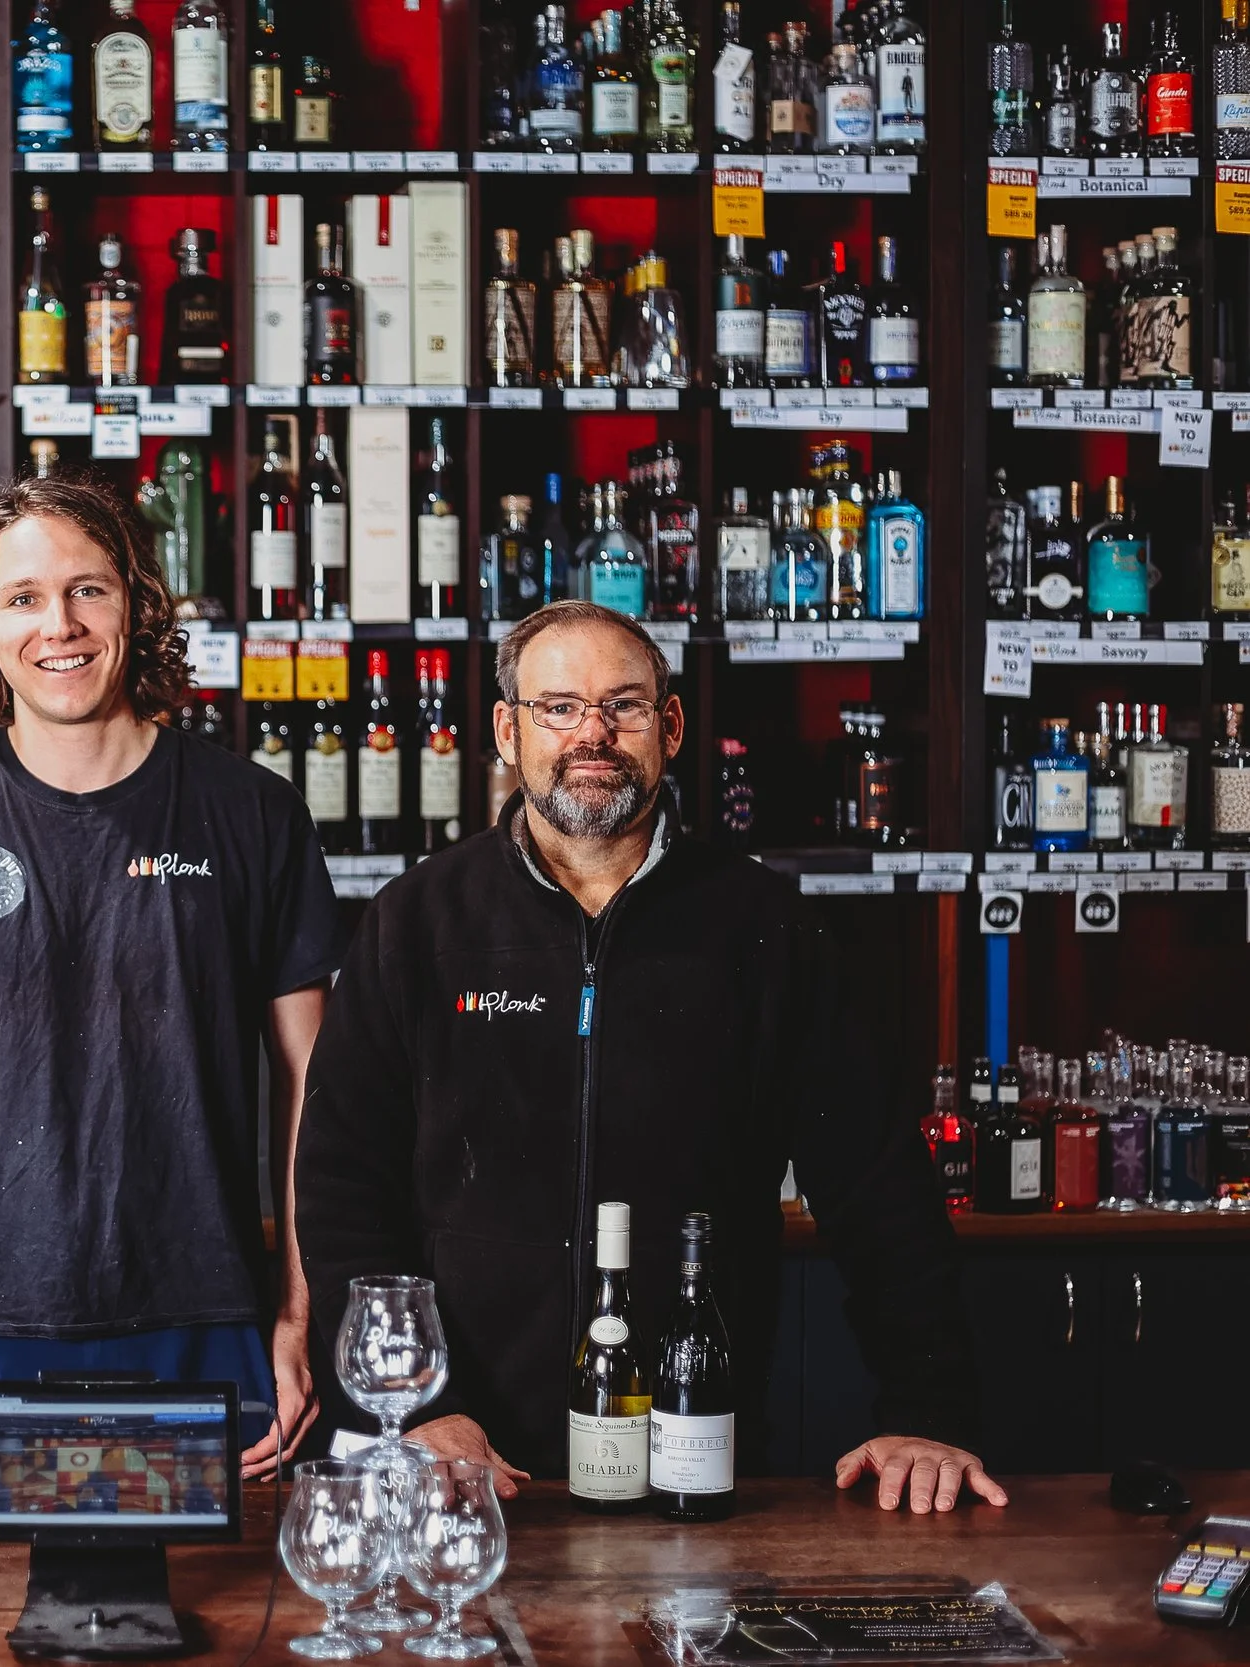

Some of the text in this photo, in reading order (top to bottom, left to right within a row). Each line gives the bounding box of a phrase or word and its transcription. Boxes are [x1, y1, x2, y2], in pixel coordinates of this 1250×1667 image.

[818, 175, 845, 190] Dry
[990, 170, 1033, 186] SPECIAL
[1080, 179, 1148, 193] Botanical
[1074, 411, 1141, 425] Botanical
[1175, 413, 1203, 424] NEW
[1180, 429, 1196, 440] TO
[812, 641, 841, 660] Dry
[998, 643, 1026, 655] NEW
[1101, 645, 1150, 661] Savory
[1002, 660, 1018, 671] TO
[0, 856, 23, 876] OUT
[158, 853, 212, 885] Plonk
[483, 991, 542, 1021] Plonk
[367, 1325, 416, 1348] Plonk
[571, 1414, 593, 1428] Domaine
[664, 1437, 728, 1449] TORBRECK
[578, 1462, 638, 1475] CHABLIS
[321, 1516, 364, 1537] Plonk
[439, 1516, 485, 1537] Plonk
[799, 1603, 918, 1614] Champagne
